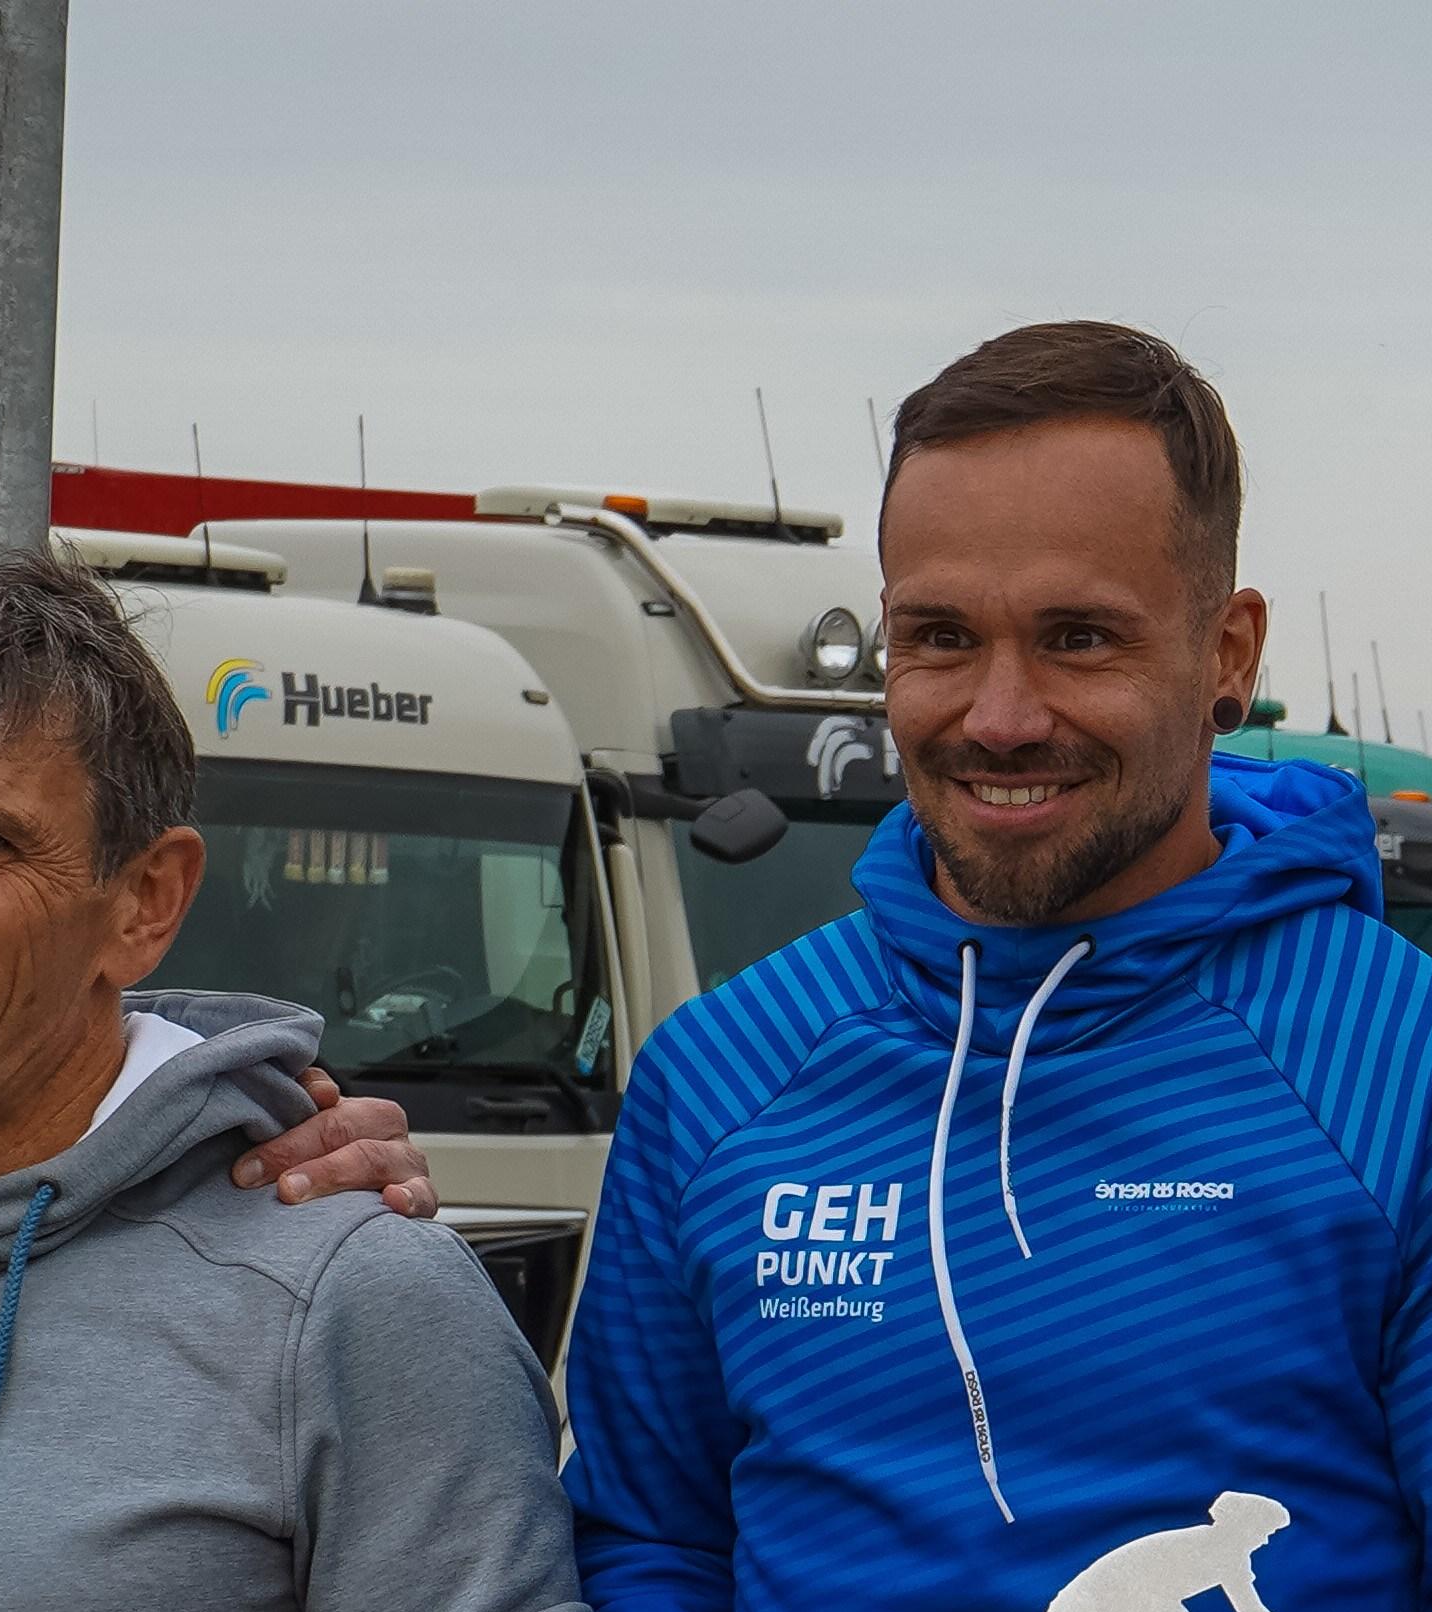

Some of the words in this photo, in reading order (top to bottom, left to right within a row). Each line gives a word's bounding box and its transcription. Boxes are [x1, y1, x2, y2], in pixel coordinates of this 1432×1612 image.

[281, 671, 433, 727] Hueber
[762, 1182, 903, 1242] GEH
[756, 1250, 894, 1287] PUNKT
[759, 1296, 885, 1323] Weißenburg
